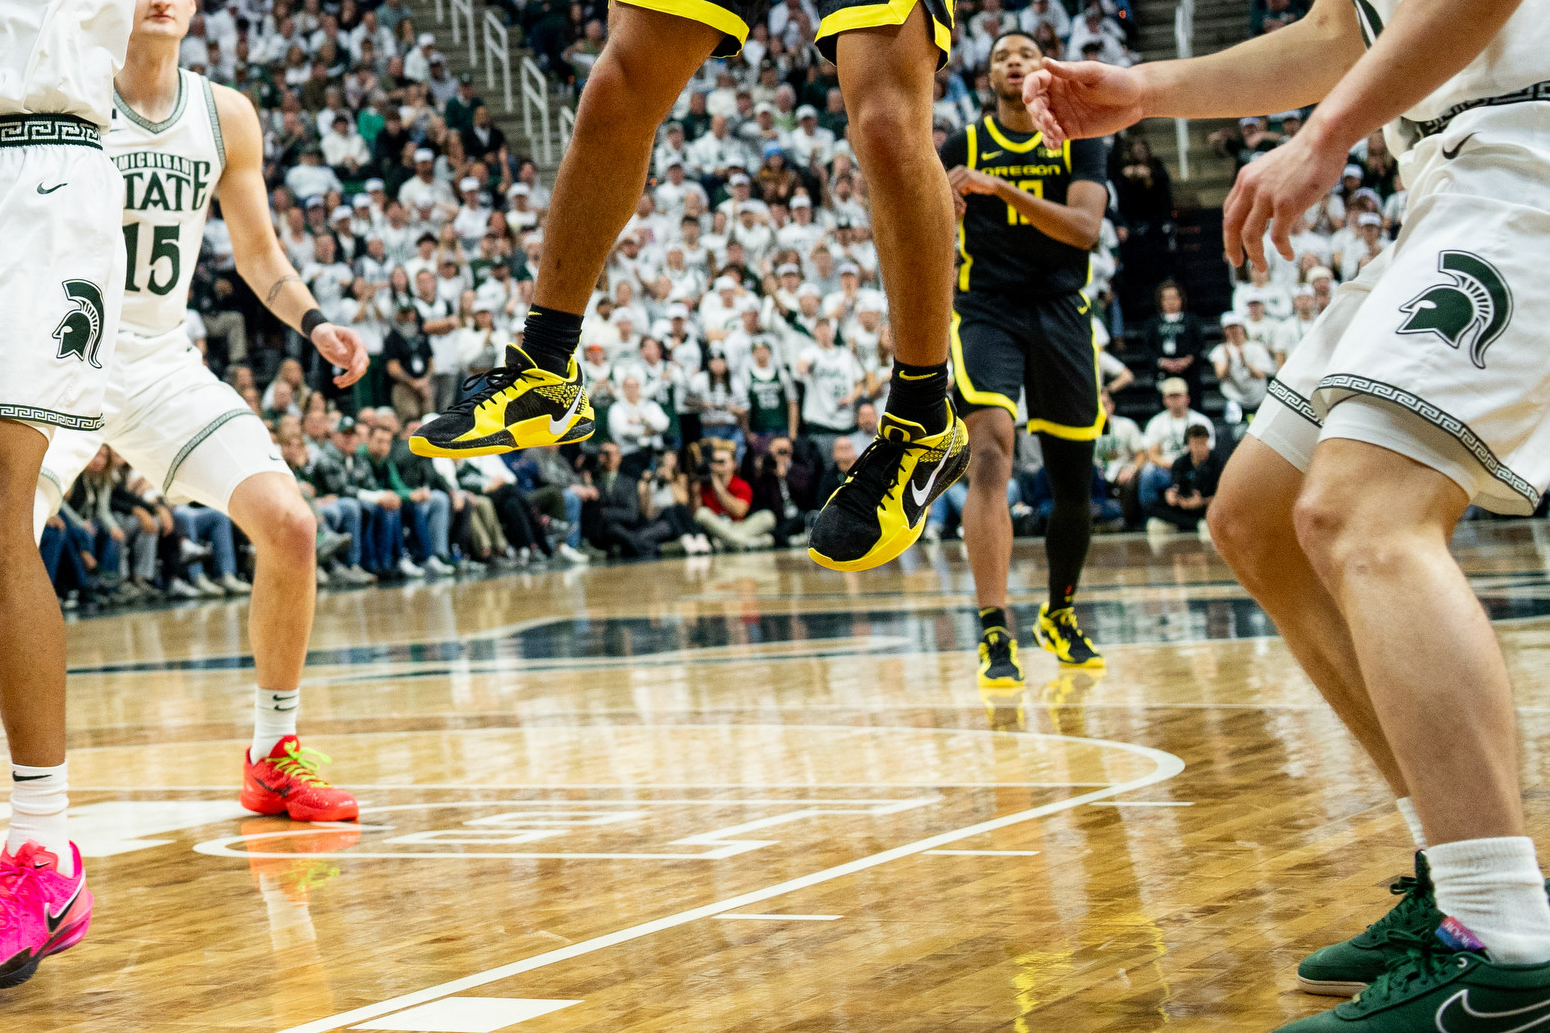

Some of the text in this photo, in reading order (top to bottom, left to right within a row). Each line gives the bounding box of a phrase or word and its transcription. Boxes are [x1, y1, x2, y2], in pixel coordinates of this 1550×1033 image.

[117, 151, 191, 175] MICHIGAN
[123, 161, 211, 211] TATE
[122, 222, 180, 296] 15
